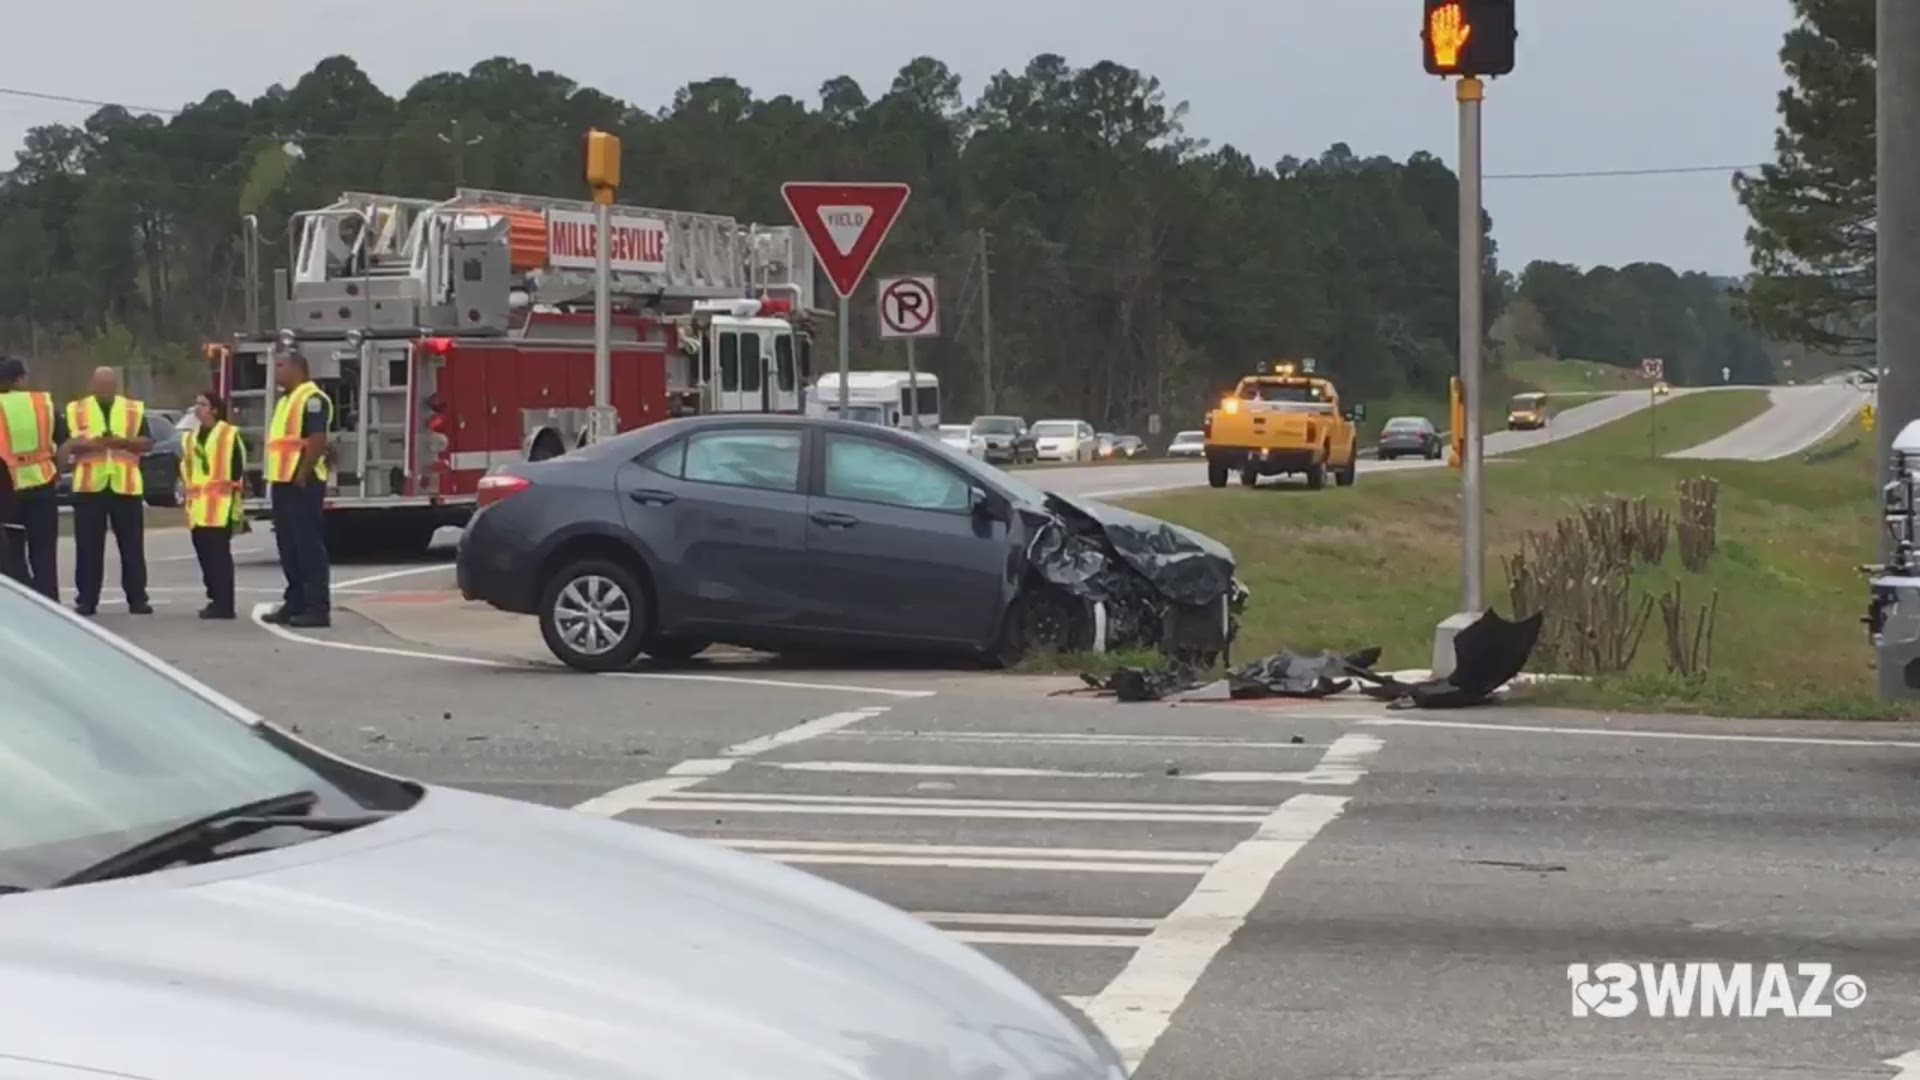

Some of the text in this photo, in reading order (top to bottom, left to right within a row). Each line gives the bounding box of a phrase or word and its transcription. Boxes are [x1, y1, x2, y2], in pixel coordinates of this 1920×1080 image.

[828, 212, 863, 228] YIELD
[553, 221, 664, 263] MILLEGEVILLE
[898, 292, 921, 324] P
